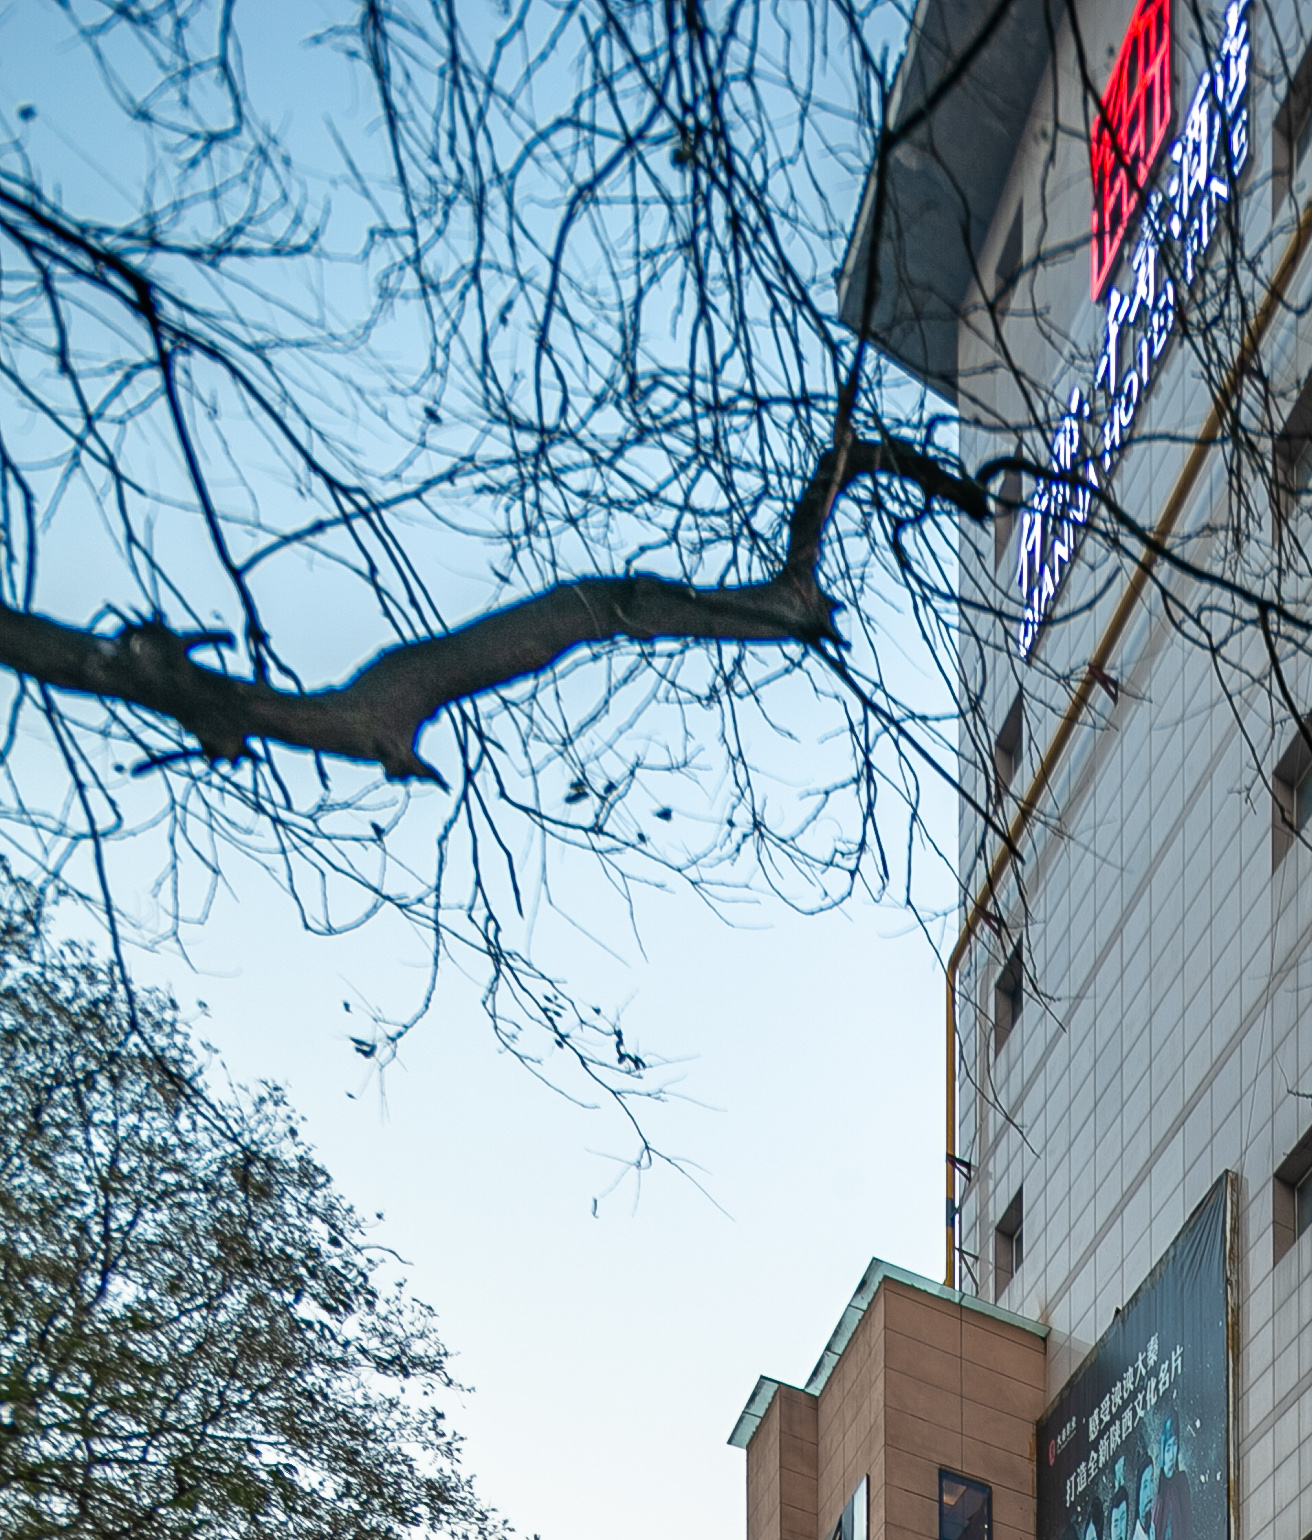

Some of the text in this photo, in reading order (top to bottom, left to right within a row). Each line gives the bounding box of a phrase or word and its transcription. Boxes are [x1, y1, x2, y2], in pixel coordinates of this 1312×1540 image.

[1066, 1345, 1184, 1507] 打造全新陕西文化名片
